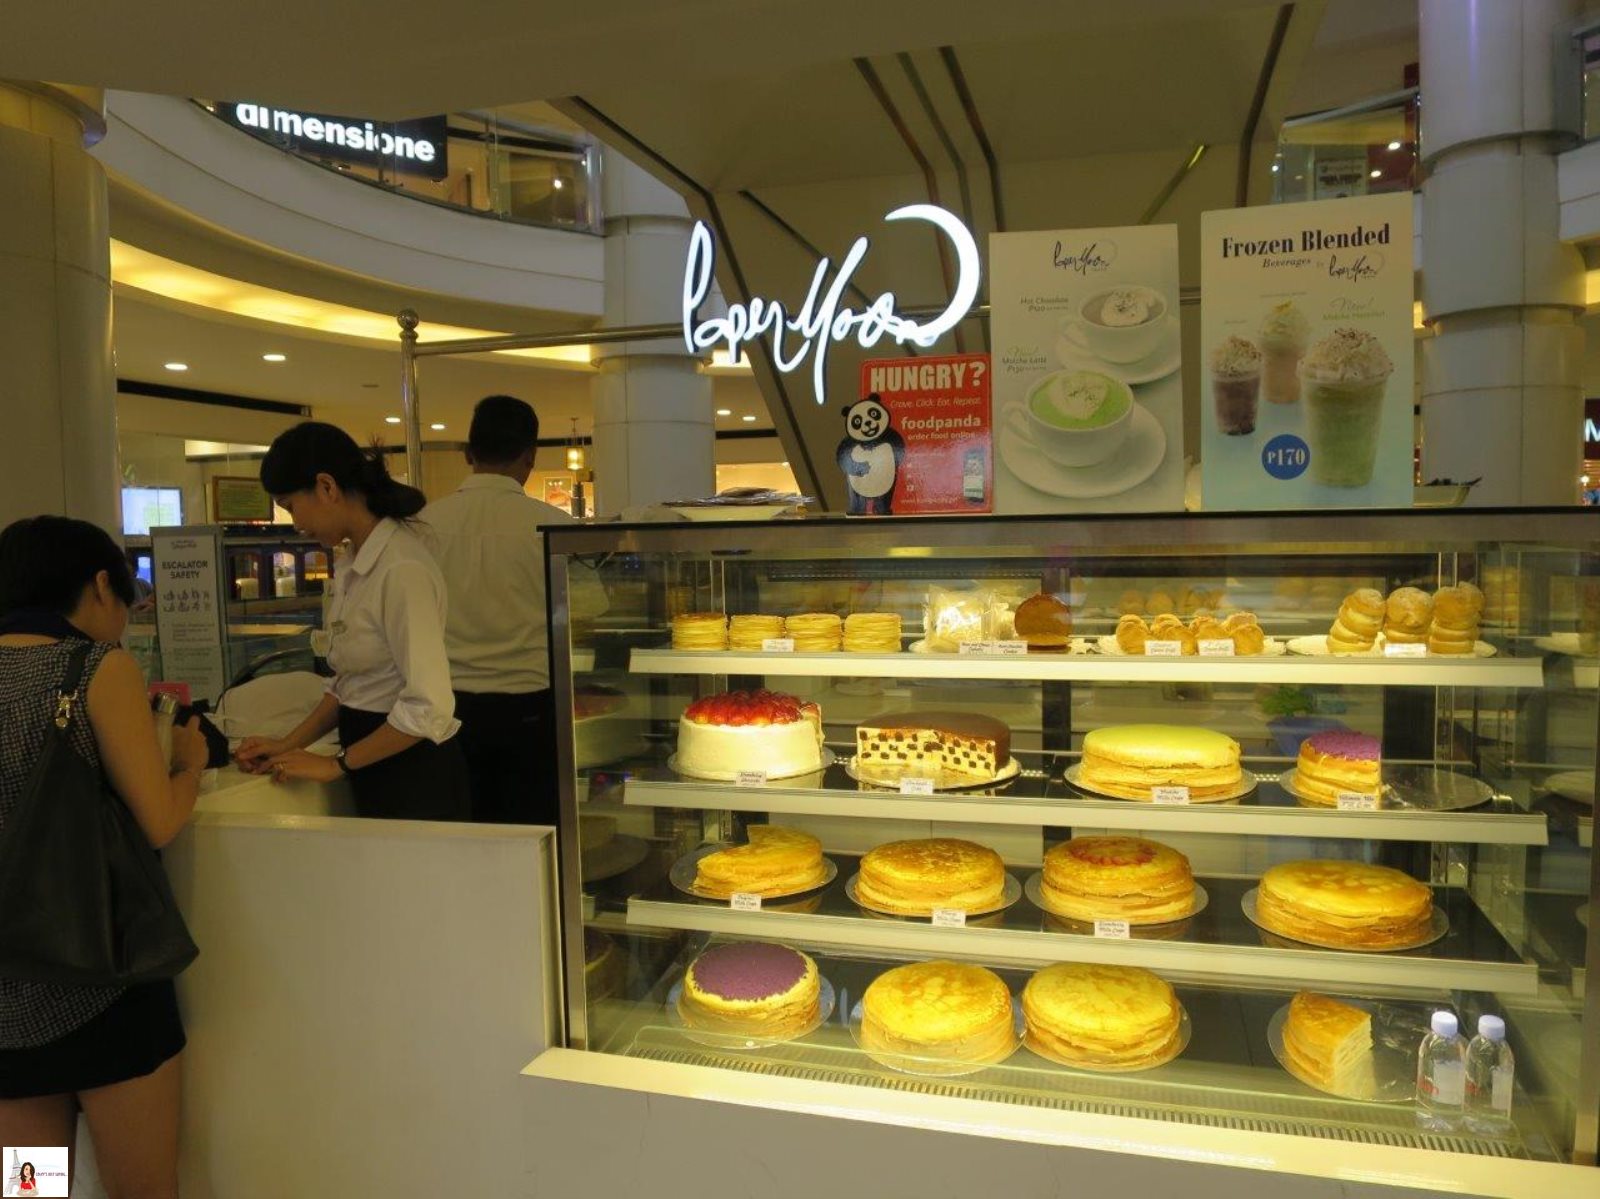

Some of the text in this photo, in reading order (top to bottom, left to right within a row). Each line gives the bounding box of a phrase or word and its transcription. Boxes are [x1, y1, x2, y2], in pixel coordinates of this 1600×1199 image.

[1222, 223, 1390, 258] Frozen Blended
[1262, 257, 1312, 268] Beverages
[900, 413, 981, 431] foodpanda
[907, 433, 929, 441] order
[930, 431, 949, 440] food
[161, 559, 208, 570] ESCALATOR
[170, 569, 200, 580] SAFETY
